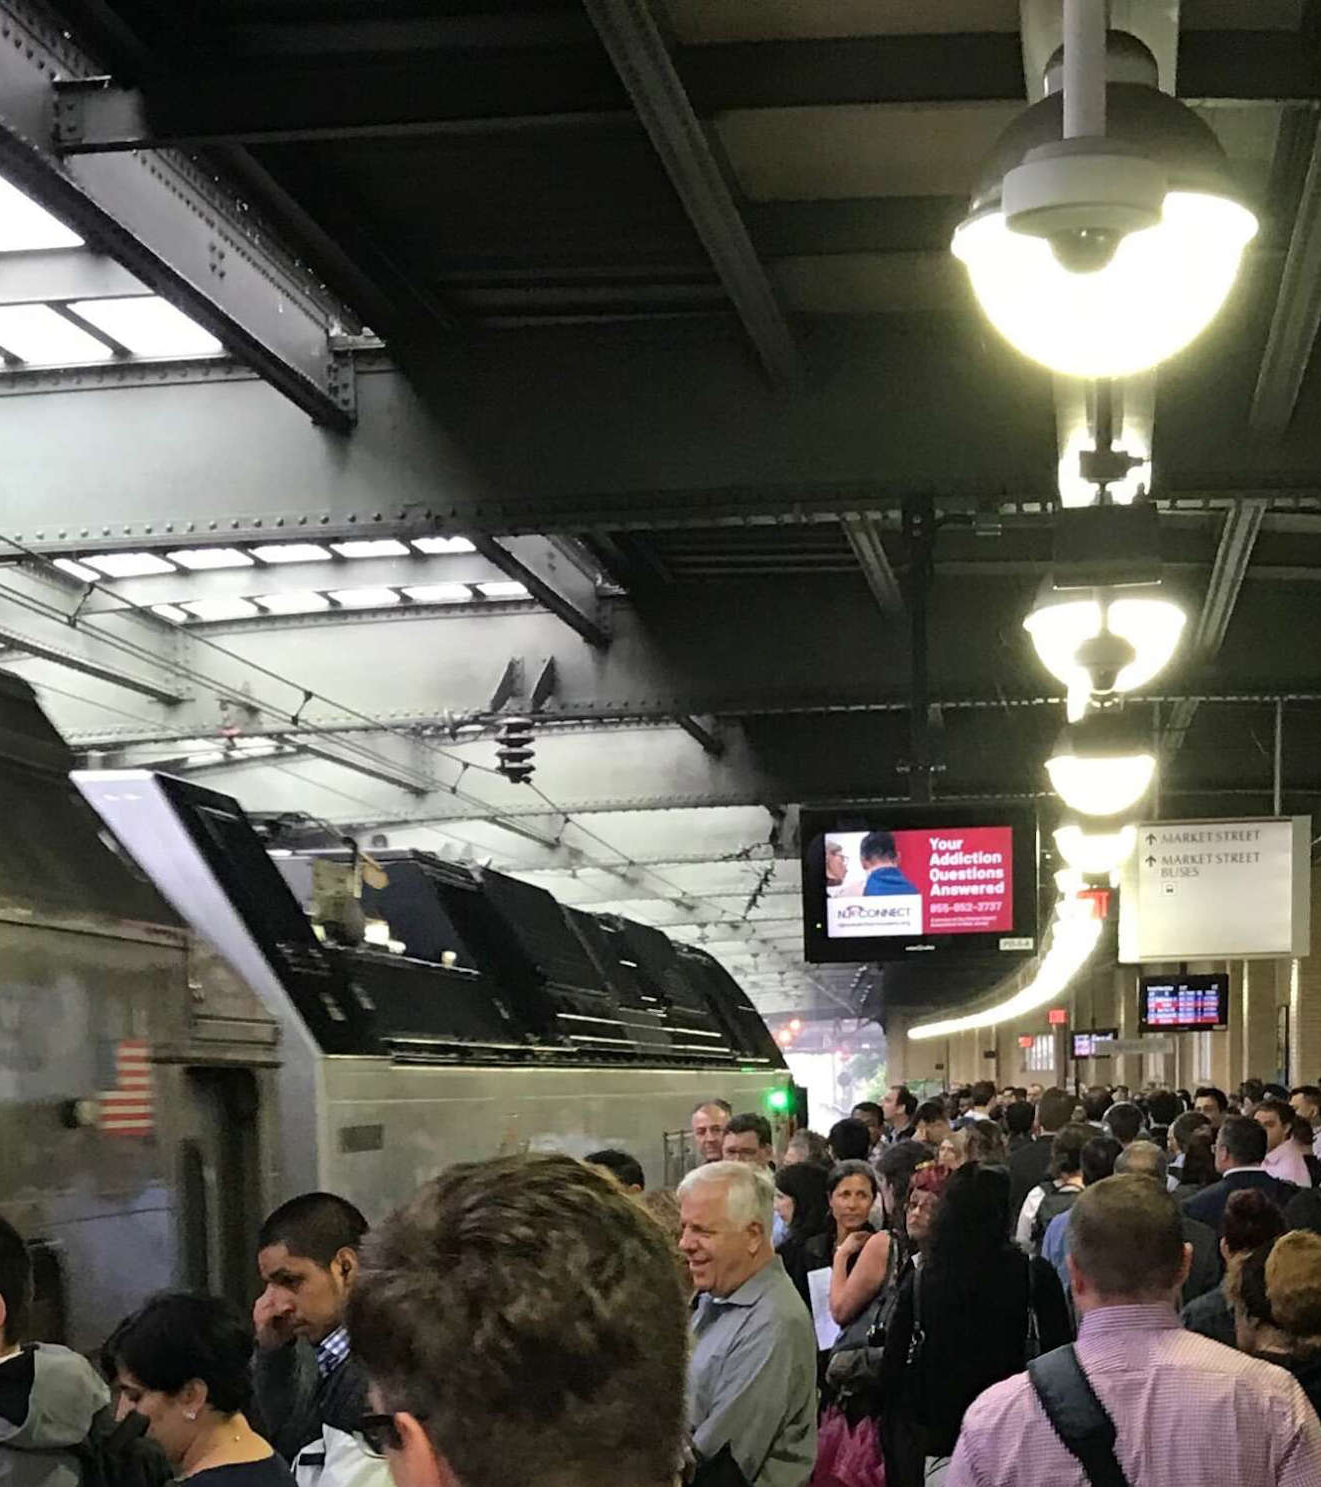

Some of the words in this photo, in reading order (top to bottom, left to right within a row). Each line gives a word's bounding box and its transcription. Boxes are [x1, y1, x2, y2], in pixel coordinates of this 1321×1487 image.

[929, 837, 964, 850] Your
[1161, 830, 1213, 844] MARKET
[1216, 829, 1261, 842] STREET
[930, 851, 1002, 866] Addiction
[1161, 853, 1213, 866] MARKET
[1216, 852, 1261, 864] STREET
[929, 867, 1005, 882] Questions
[930, 882, 1005, 897] Answered
